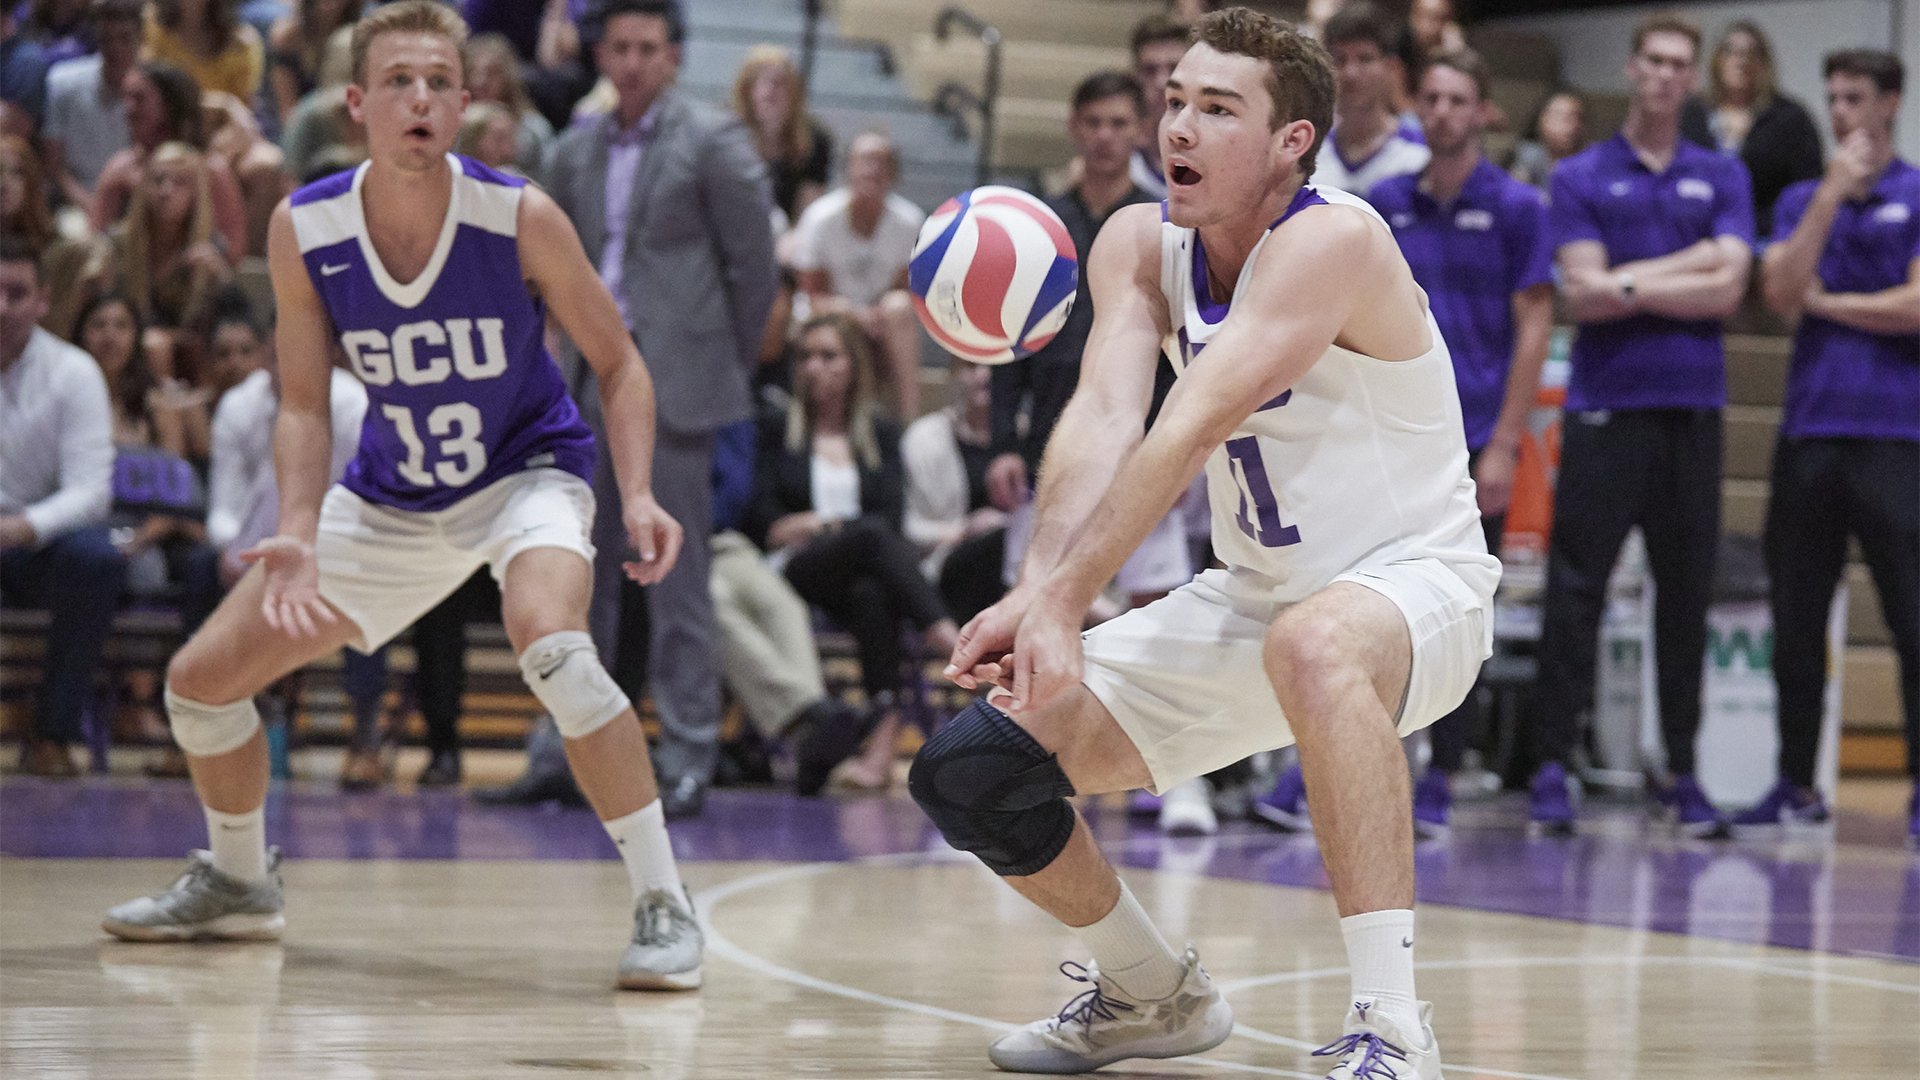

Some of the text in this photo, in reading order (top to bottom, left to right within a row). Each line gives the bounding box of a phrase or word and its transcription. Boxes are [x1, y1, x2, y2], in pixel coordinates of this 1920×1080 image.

[341, 318, 508, 387] GCU
[112, 454, 193, 505] CU
[381, 401, 487, 488] 13
[1224, 435, 1302, 548] 11
